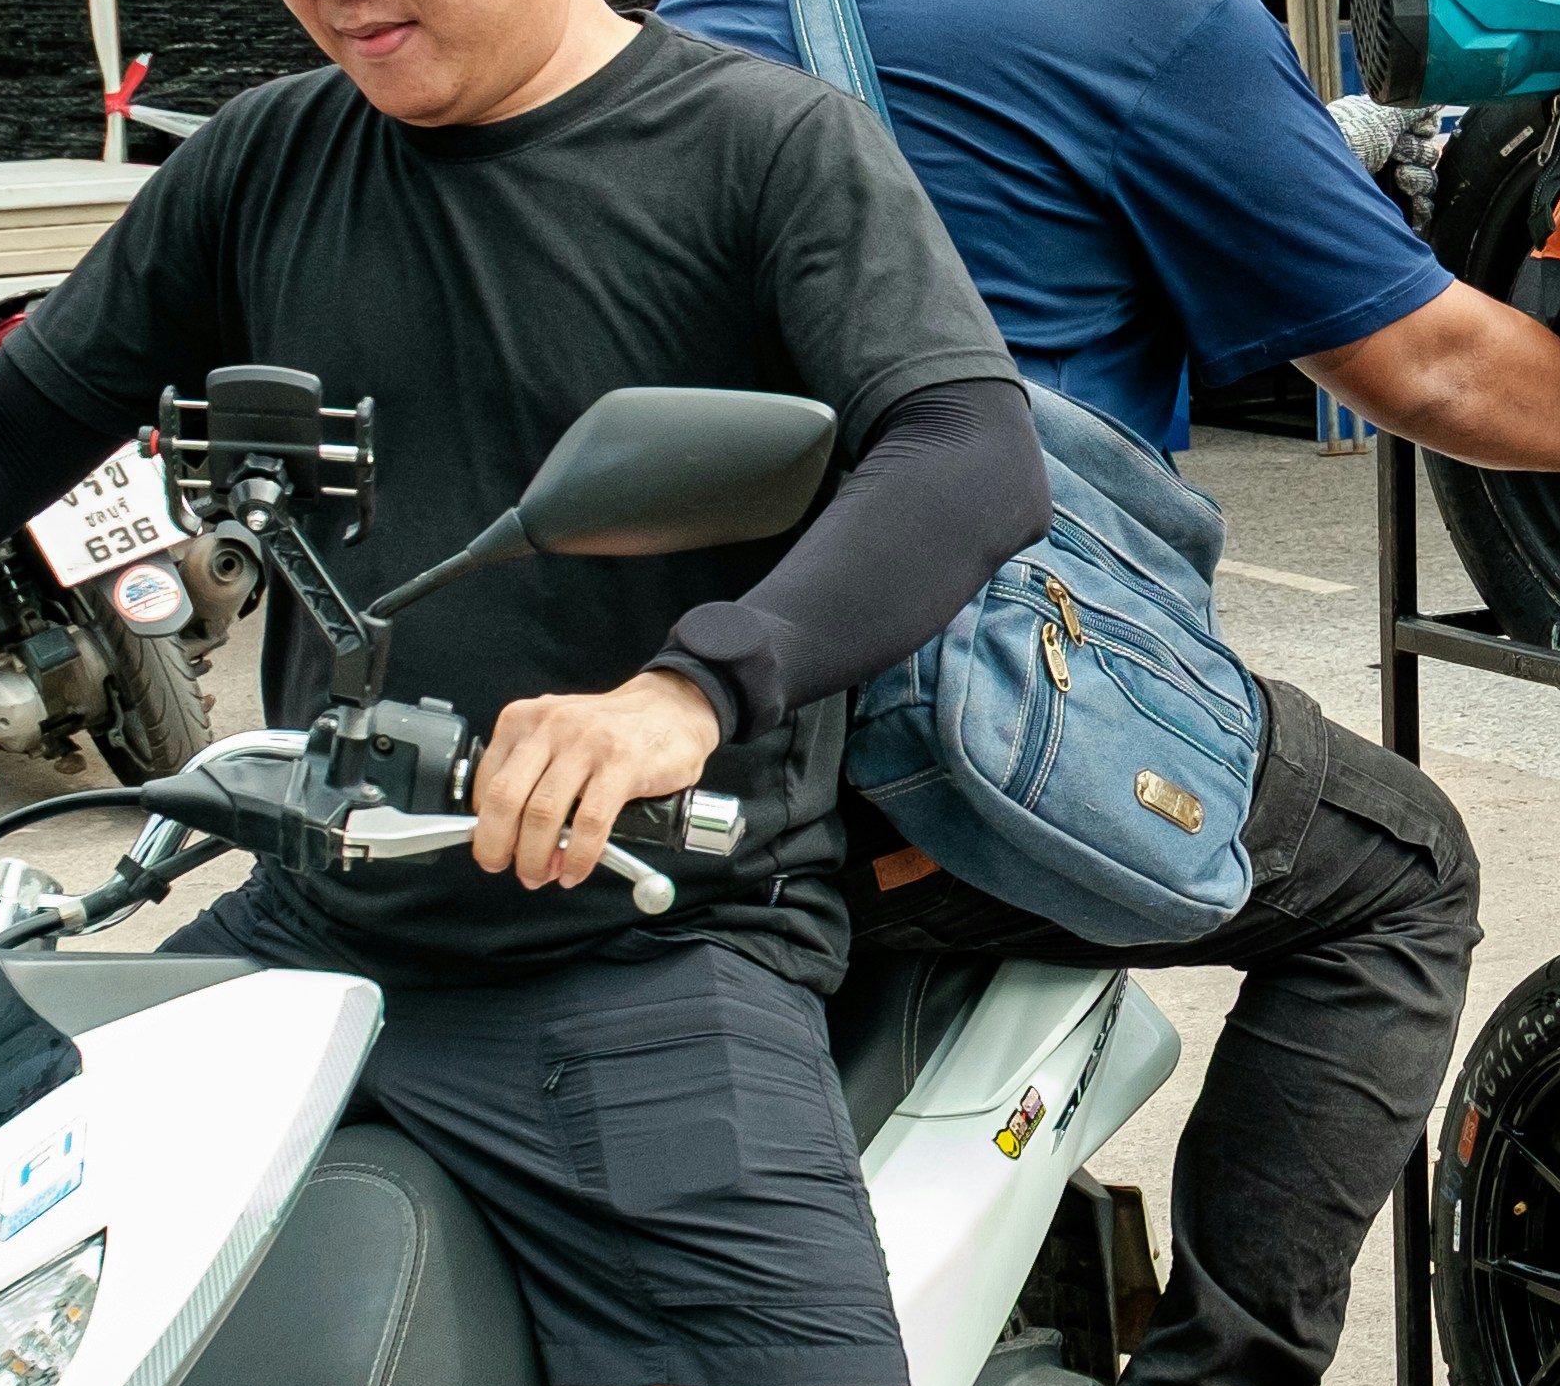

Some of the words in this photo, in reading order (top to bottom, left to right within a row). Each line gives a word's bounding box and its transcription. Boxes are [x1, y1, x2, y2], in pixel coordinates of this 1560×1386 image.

[84, 497, 131, 528] ชลบุรี
[84, 516, 160, 564] 636
